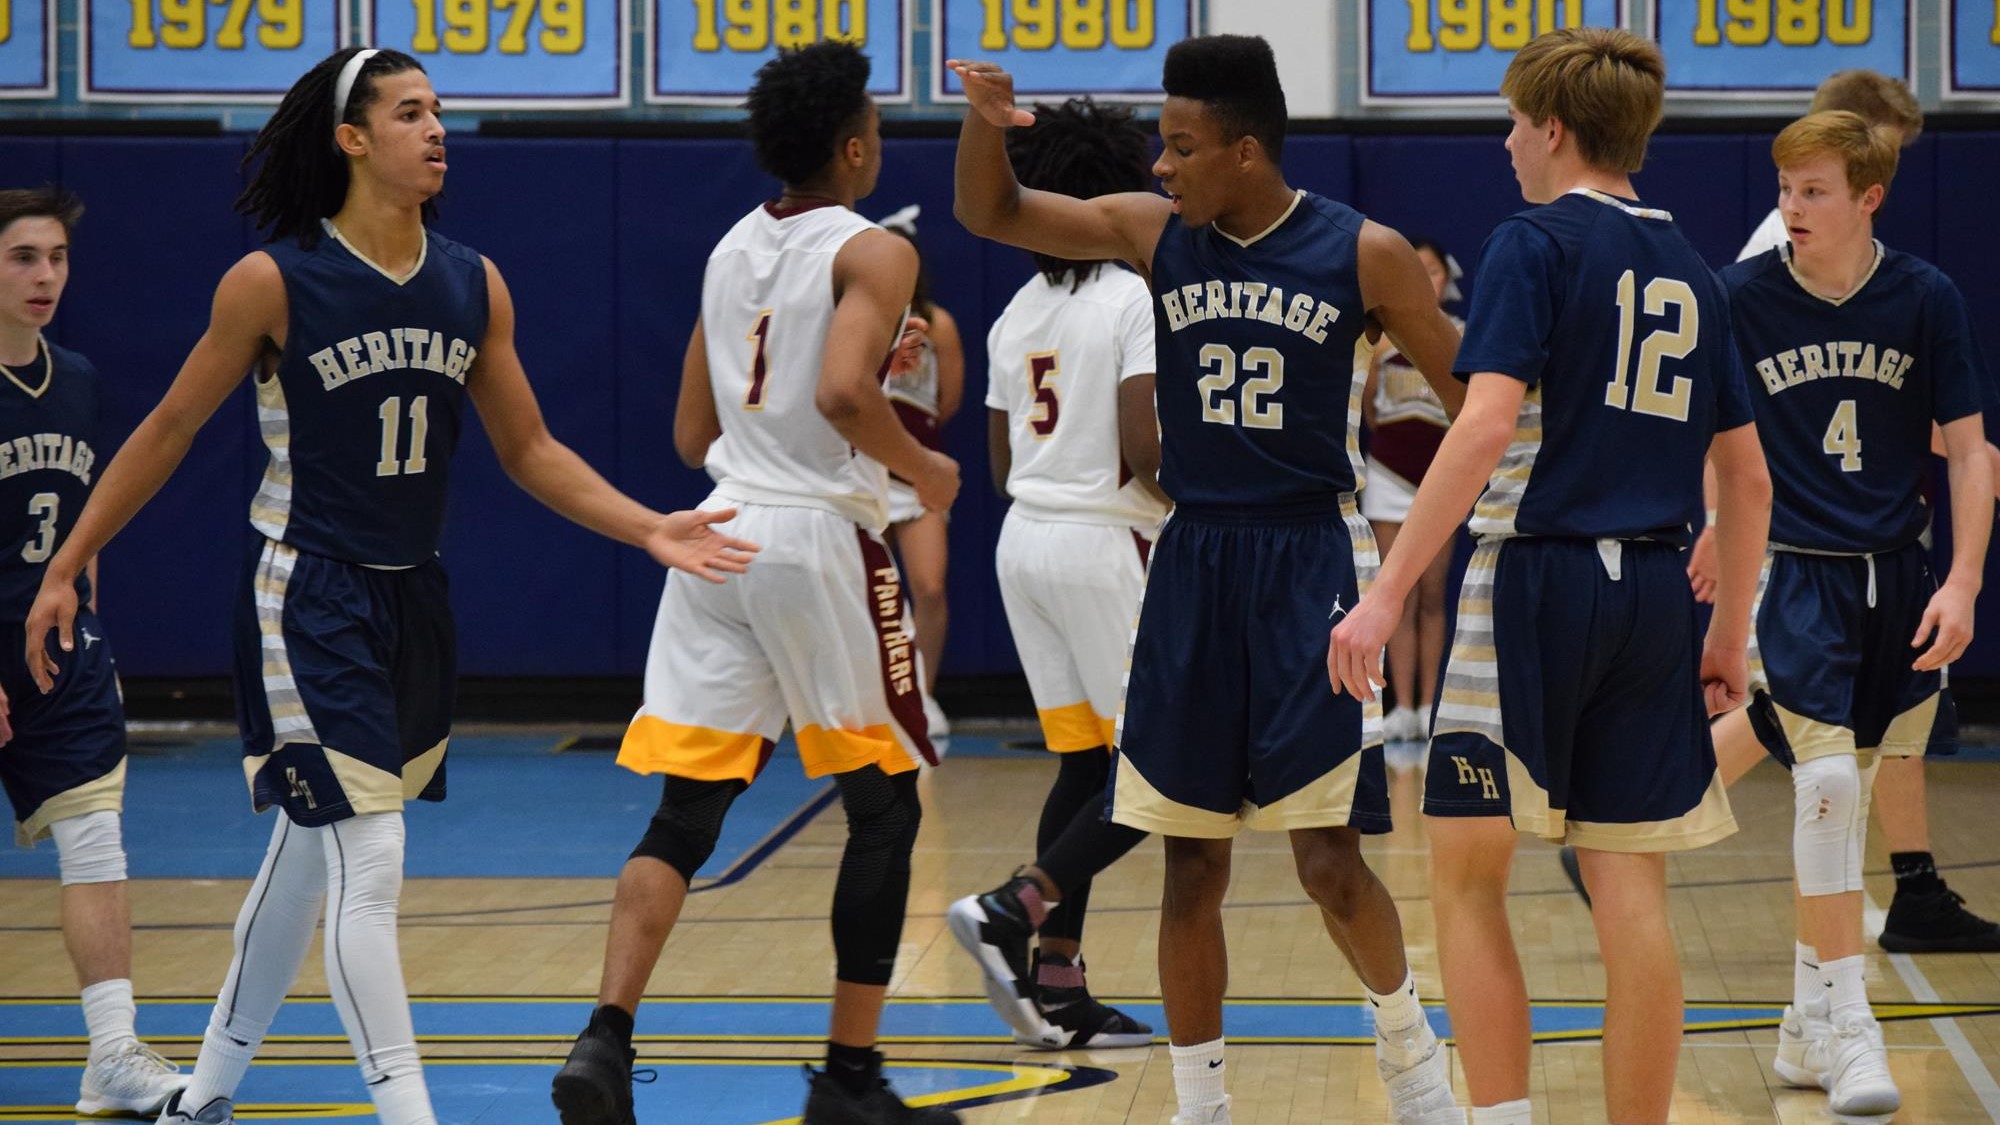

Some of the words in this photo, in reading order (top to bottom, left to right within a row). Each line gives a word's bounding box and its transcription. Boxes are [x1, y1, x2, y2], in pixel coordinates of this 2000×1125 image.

[128, 0, 305, 49] 1979
[411, 0, 586, 54] 1979
[692, 0, 868, 52] 1980
[980, 0, 1156, 50] 1980
[1693, 0, 1873, 46] 1980
[1161, 280, 1341, 345] HERITAGE
[1605, 269, 1699, 422] 12
[743, 307, 773, 410] 1
[1197, 343, 1285, 430] 22
[1755, 341, 1915, 396] HERITAGE
[1024, 349, 1062, 441] 5
[0, 433, 95, 486] ERITAGE
[376, 395, 429, 477] 11
[1823, 400, 1862, 472] 4
[21, 492, 60, 563] 3
[873, 565, 913, 696] PANTHERS
